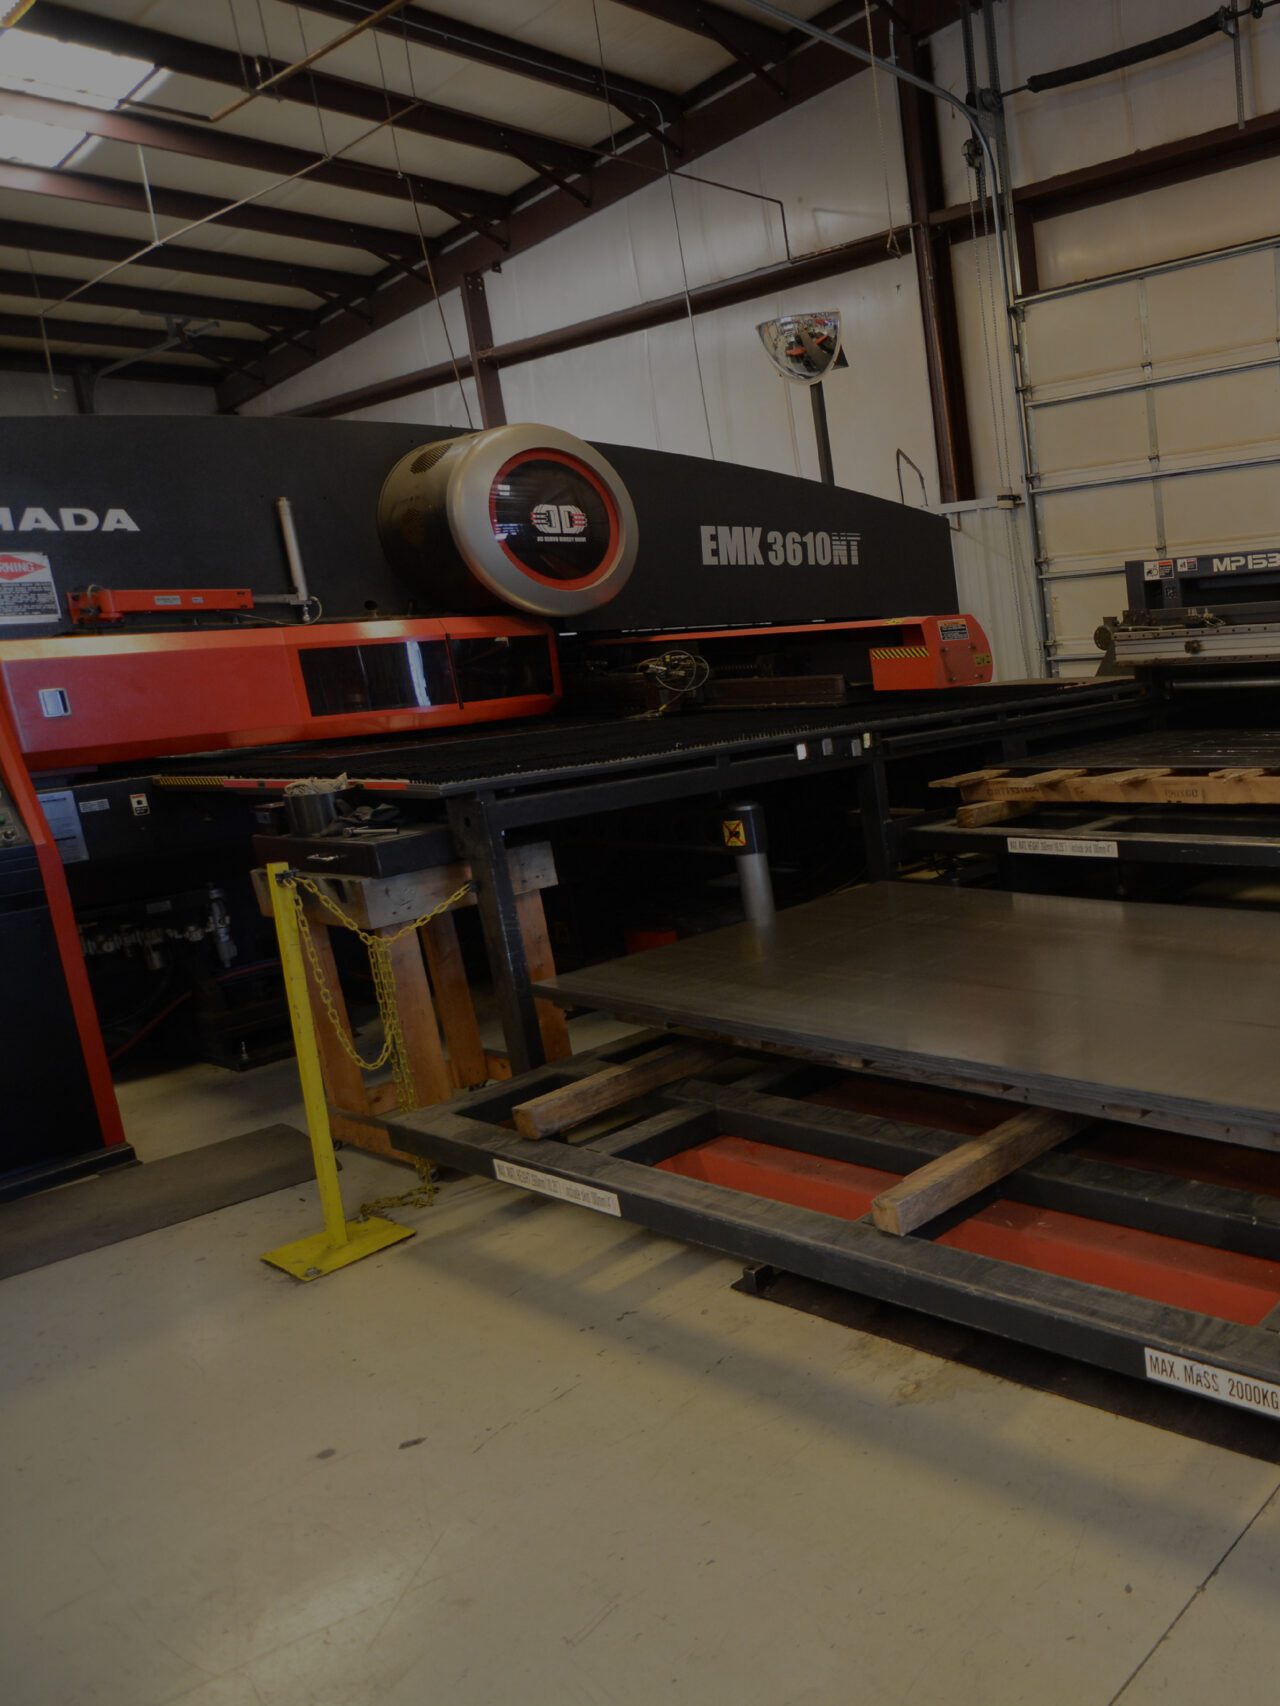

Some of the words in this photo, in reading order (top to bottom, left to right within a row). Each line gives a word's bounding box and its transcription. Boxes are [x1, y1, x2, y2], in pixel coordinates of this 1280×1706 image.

[700, 525, 765, 566] EMK
[1149, 1355, 1180, 1382] MAX.
[1228, 1377, 1279, 1410] 2000KG
